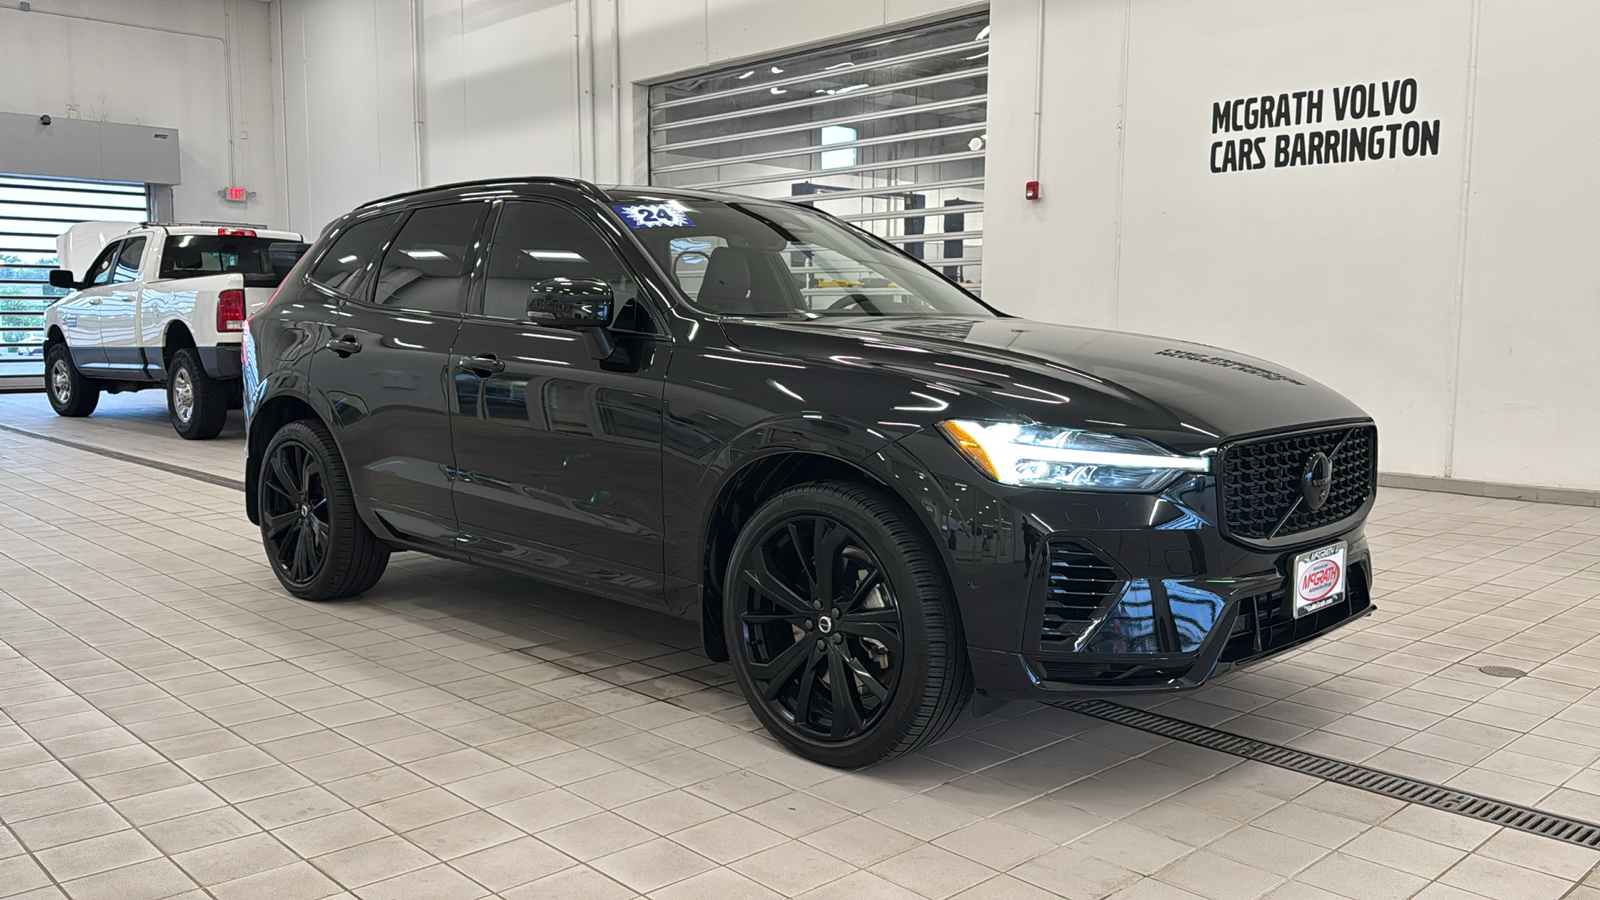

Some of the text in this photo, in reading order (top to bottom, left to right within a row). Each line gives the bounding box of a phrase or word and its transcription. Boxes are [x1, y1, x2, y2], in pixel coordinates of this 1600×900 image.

[1212, 78, 1417, 134] MCGRATH VOLVO
[1210, 119, 1440, 173] CARS BARRINGTON
[229, 188, 243, 199] EXIT
[638, 208, 674, 222] 24
